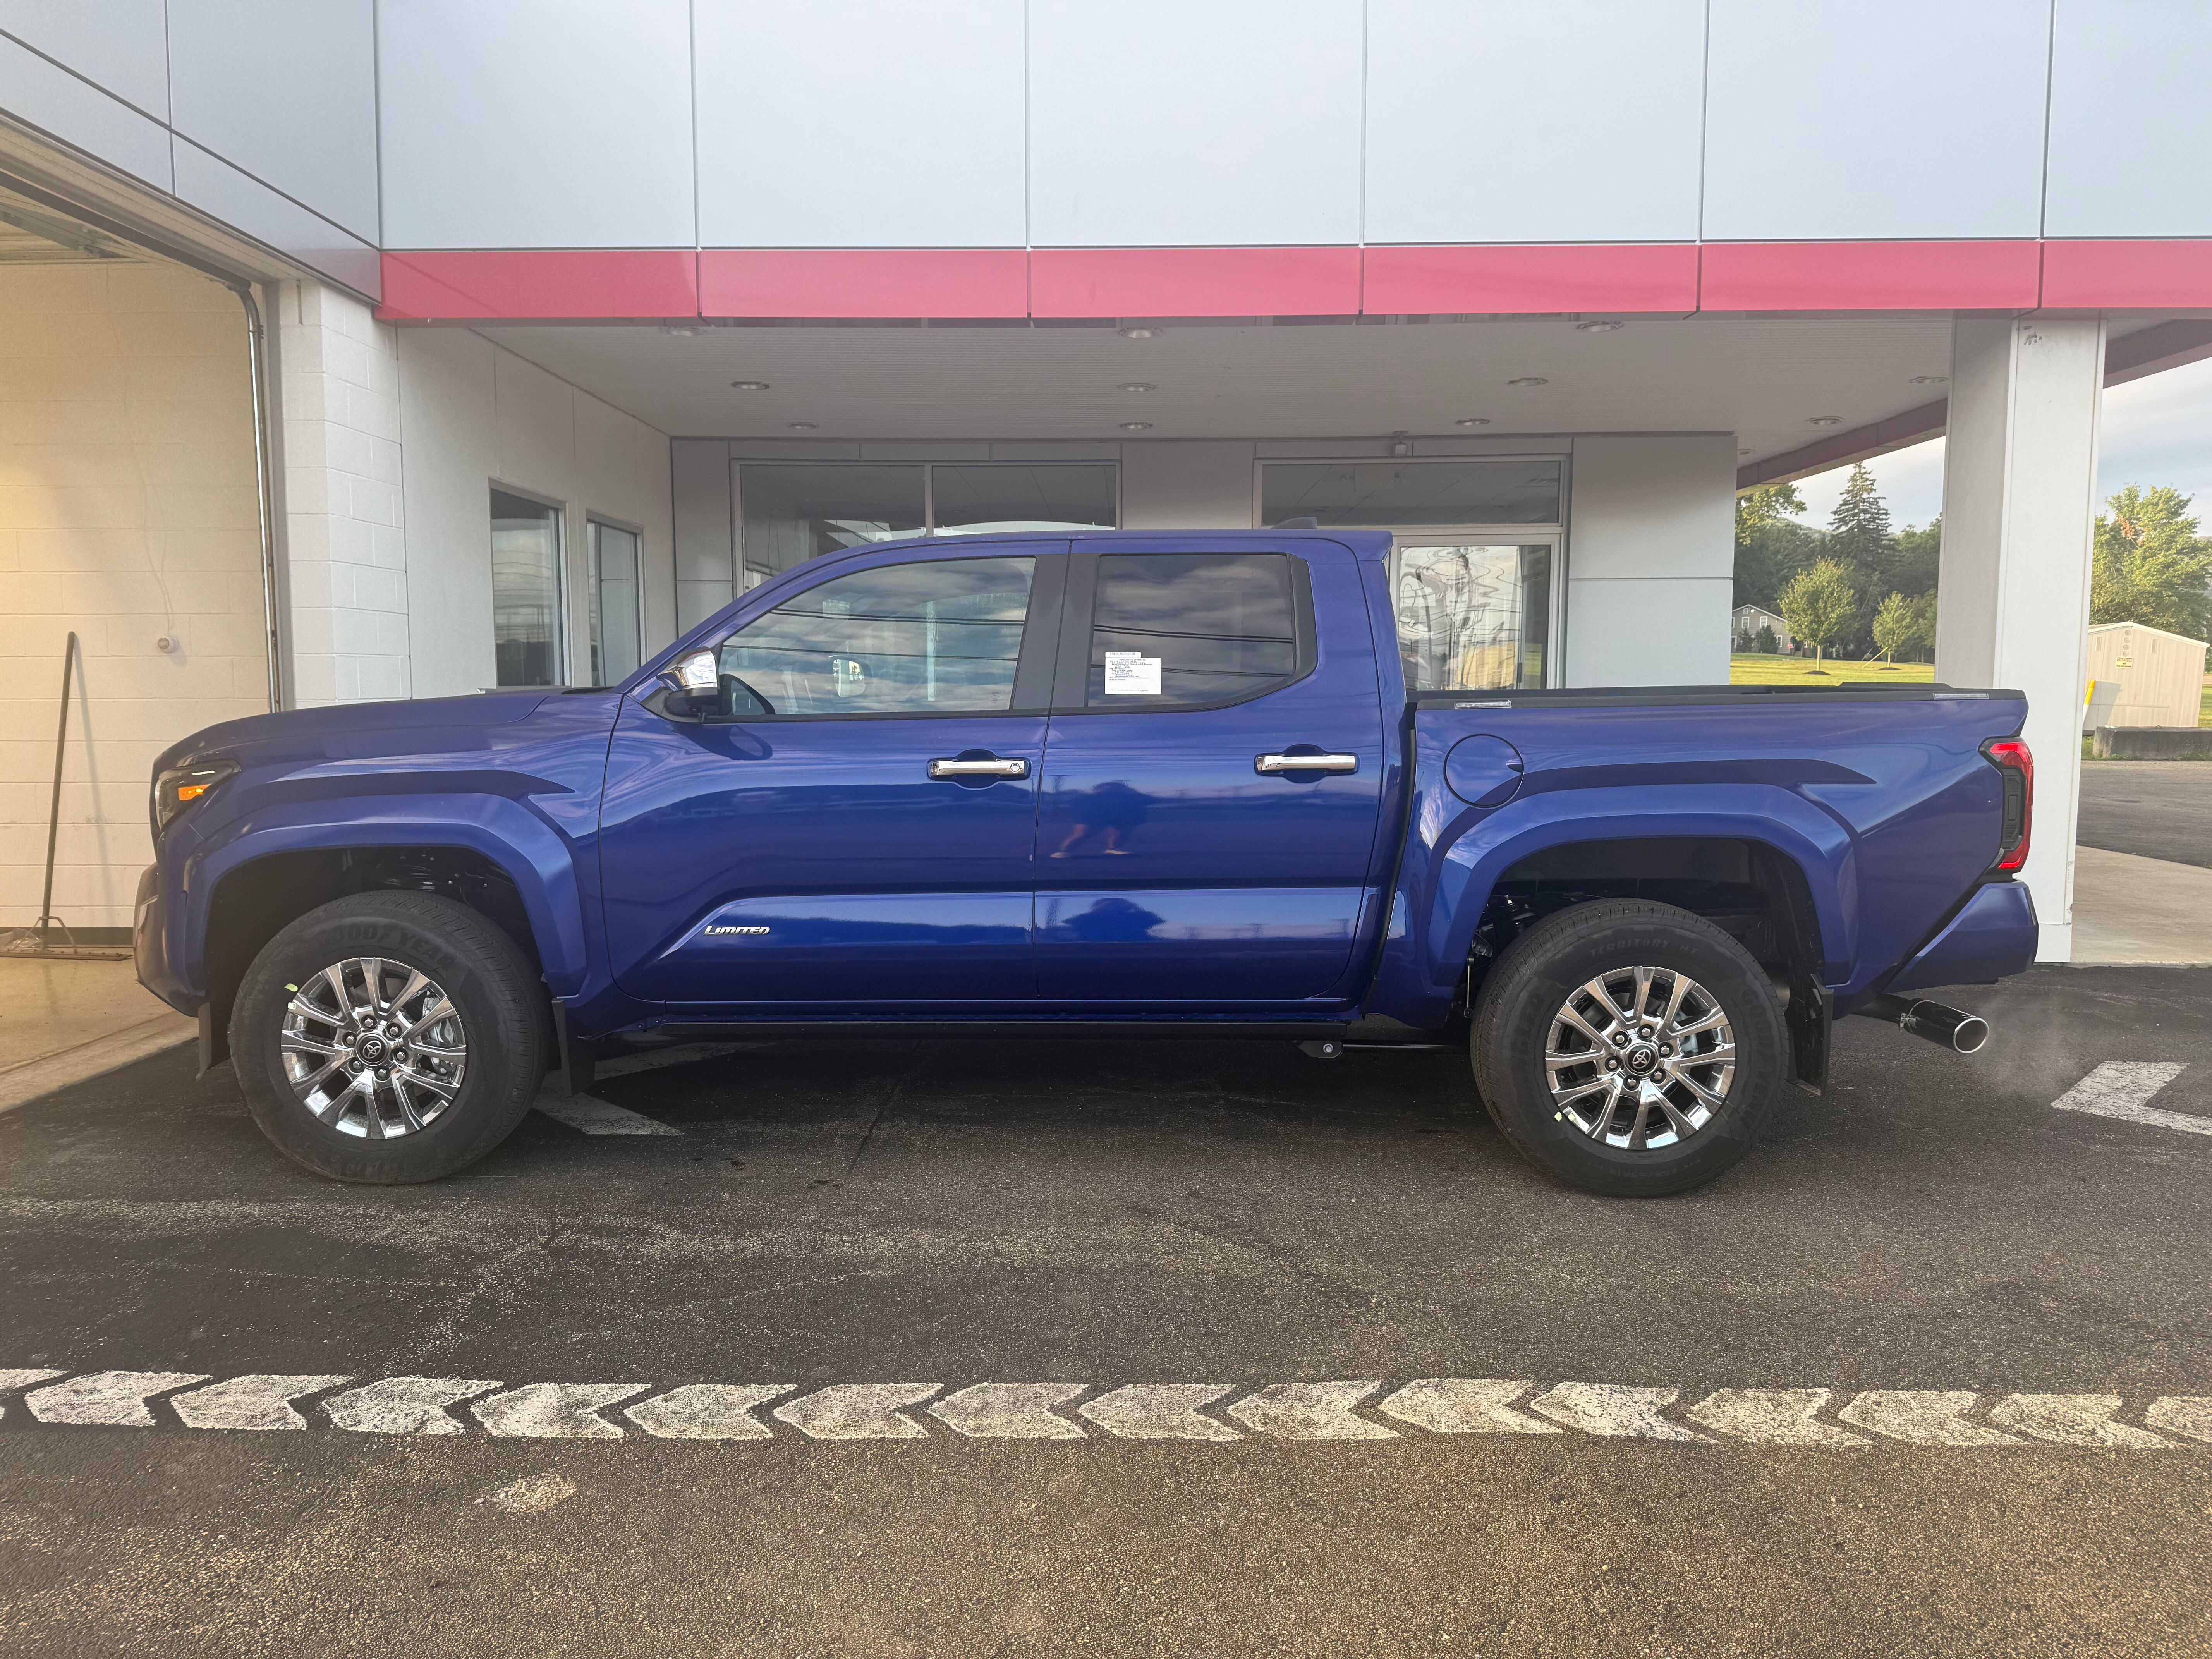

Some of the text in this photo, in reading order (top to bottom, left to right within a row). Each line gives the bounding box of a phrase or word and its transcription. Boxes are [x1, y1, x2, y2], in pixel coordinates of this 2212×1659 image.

[704, 926, 770, 936] LIMITED
[1589, 938, 1699, 957] TERRITORY HT
